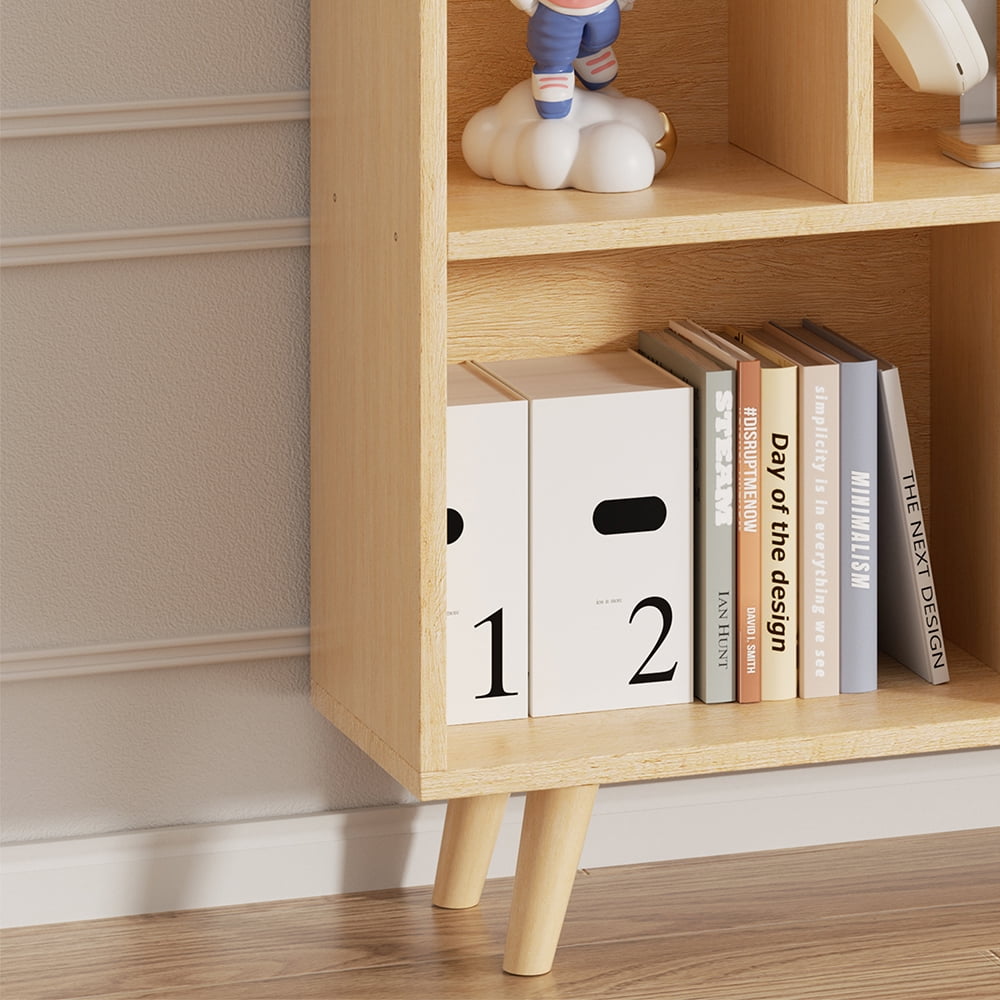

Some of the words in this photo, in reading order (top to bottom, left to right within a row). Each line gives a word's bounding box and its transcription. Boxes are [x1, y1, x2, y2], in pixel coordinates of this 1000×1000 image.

[811, 385, 828, 472] simplicity
[715, 390, 733, 527] STEAM
[743, 407, 757, 533] #DISRUPTMENOW
[767, 433, 789, 480] Day
[771, 488, 790, 515] of
[815, 478, 828, 493] is
[815, 500, 828, 515] in
[903, 469, 920, 514] THE
[771, 521, 790, 562] the
[851, 470, 870, 590] MINIMALISM
[910, 520, 931, 578] NEXT
[811, 522, 829, 614] everything
[718, 591, 730, 619] IAN
[746, 607, 756, 635] DAVID
[766, 569, 790, 652] design
[921, 585, 945, 669] DESIGN
[474, 607, 519, 700] 1
[628, 596, 678, 685] 2
[718, 624, 730, 670] HUNT
[815, 620, 825, 642] we
[746, 644, 756, 674] SMITH
[815, 650, 825, 677] see
